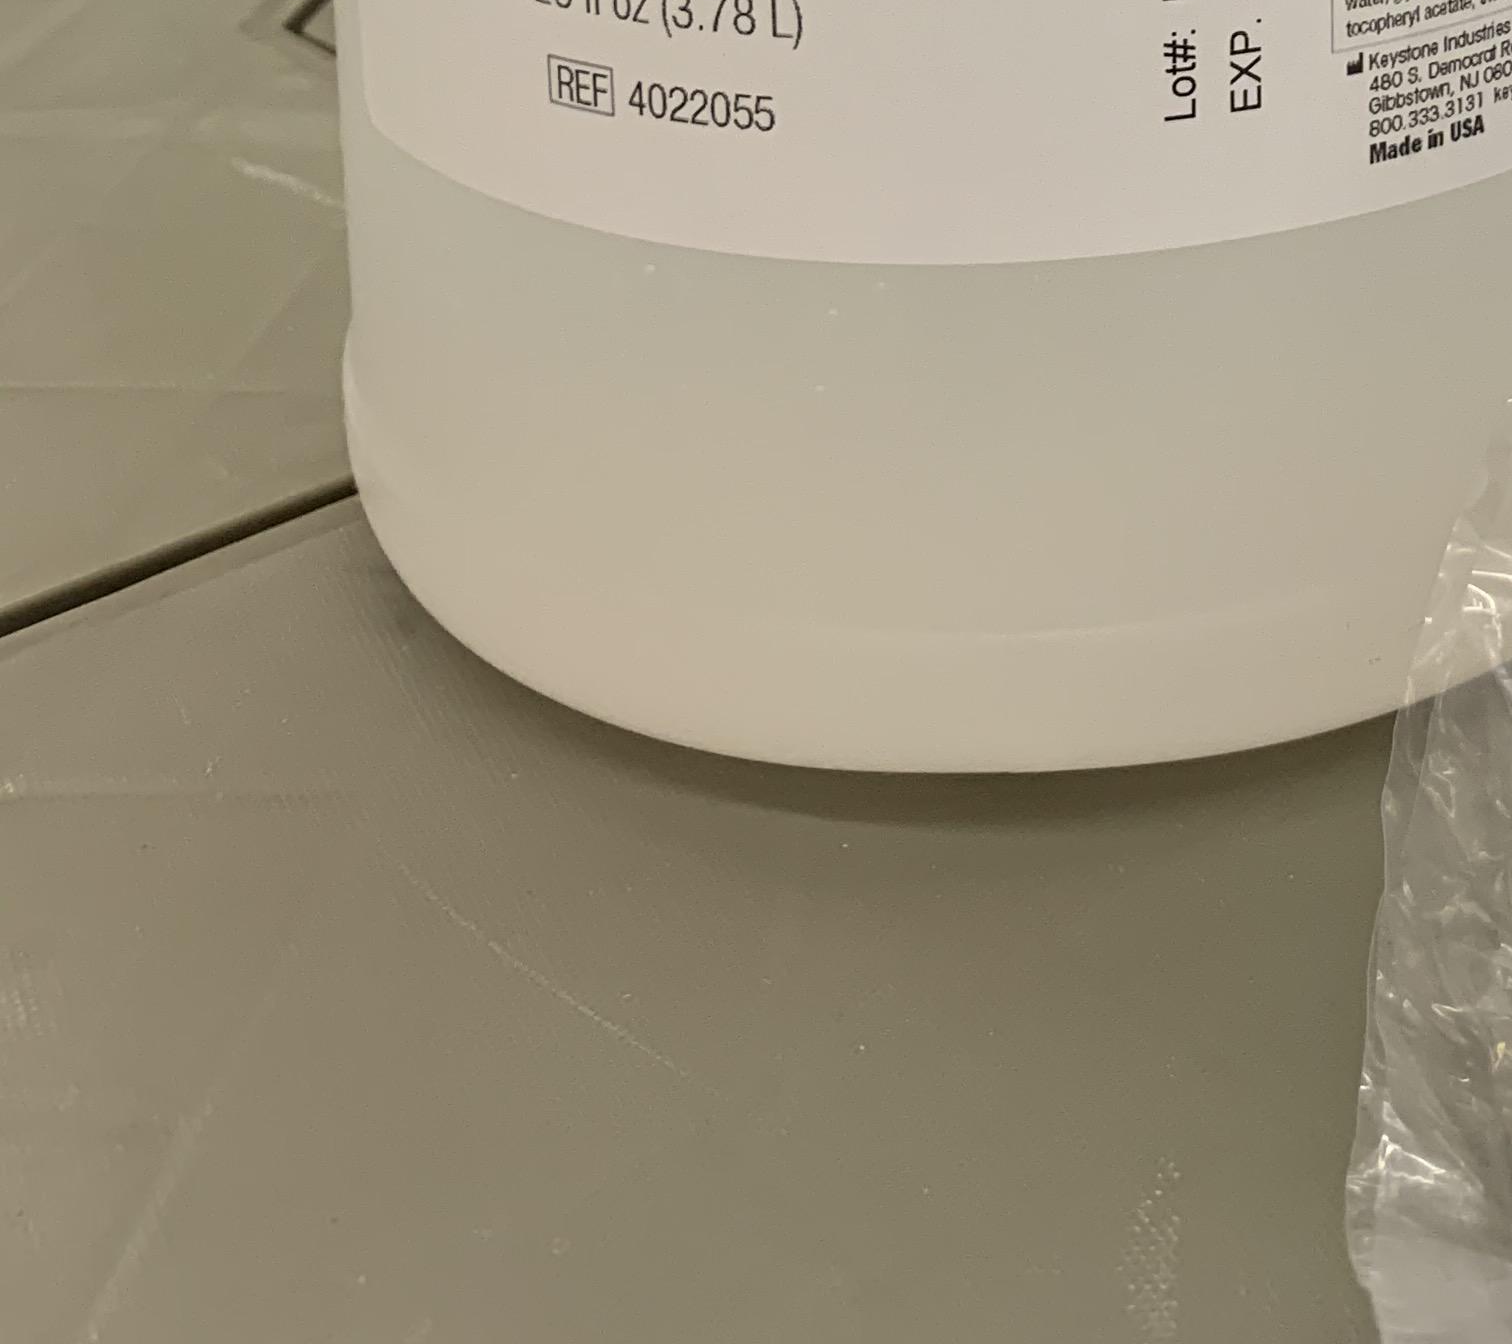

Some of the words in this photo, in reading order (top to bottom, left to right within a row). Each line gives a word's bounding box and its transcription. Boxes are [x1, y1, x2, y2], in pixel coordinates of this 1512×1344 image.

[1230, 19, 1261, 112] EXP.
[1368, 41, 1439, 71] Keystone
[1443, 20, 1511, 53] Industries
[1369, 70, 1404, 93] 480
[1428, 43, 1497, 80] Democrat
[556, 63, 610, 108] REF
[629, 81, 775, 131] 4022055
[1164, 30, 1196, 121] Lot#:
[1368, 81, 1455, 116] Gibbstown,
[1459, 70, 1480, 92] NJ
[1368, 91, 1483, 138] 800.333.3131
[1369, 140, 1422, 164] Made
[1428, 129, 1444, 150] in
[1451, 114, 1484, 141] USA
